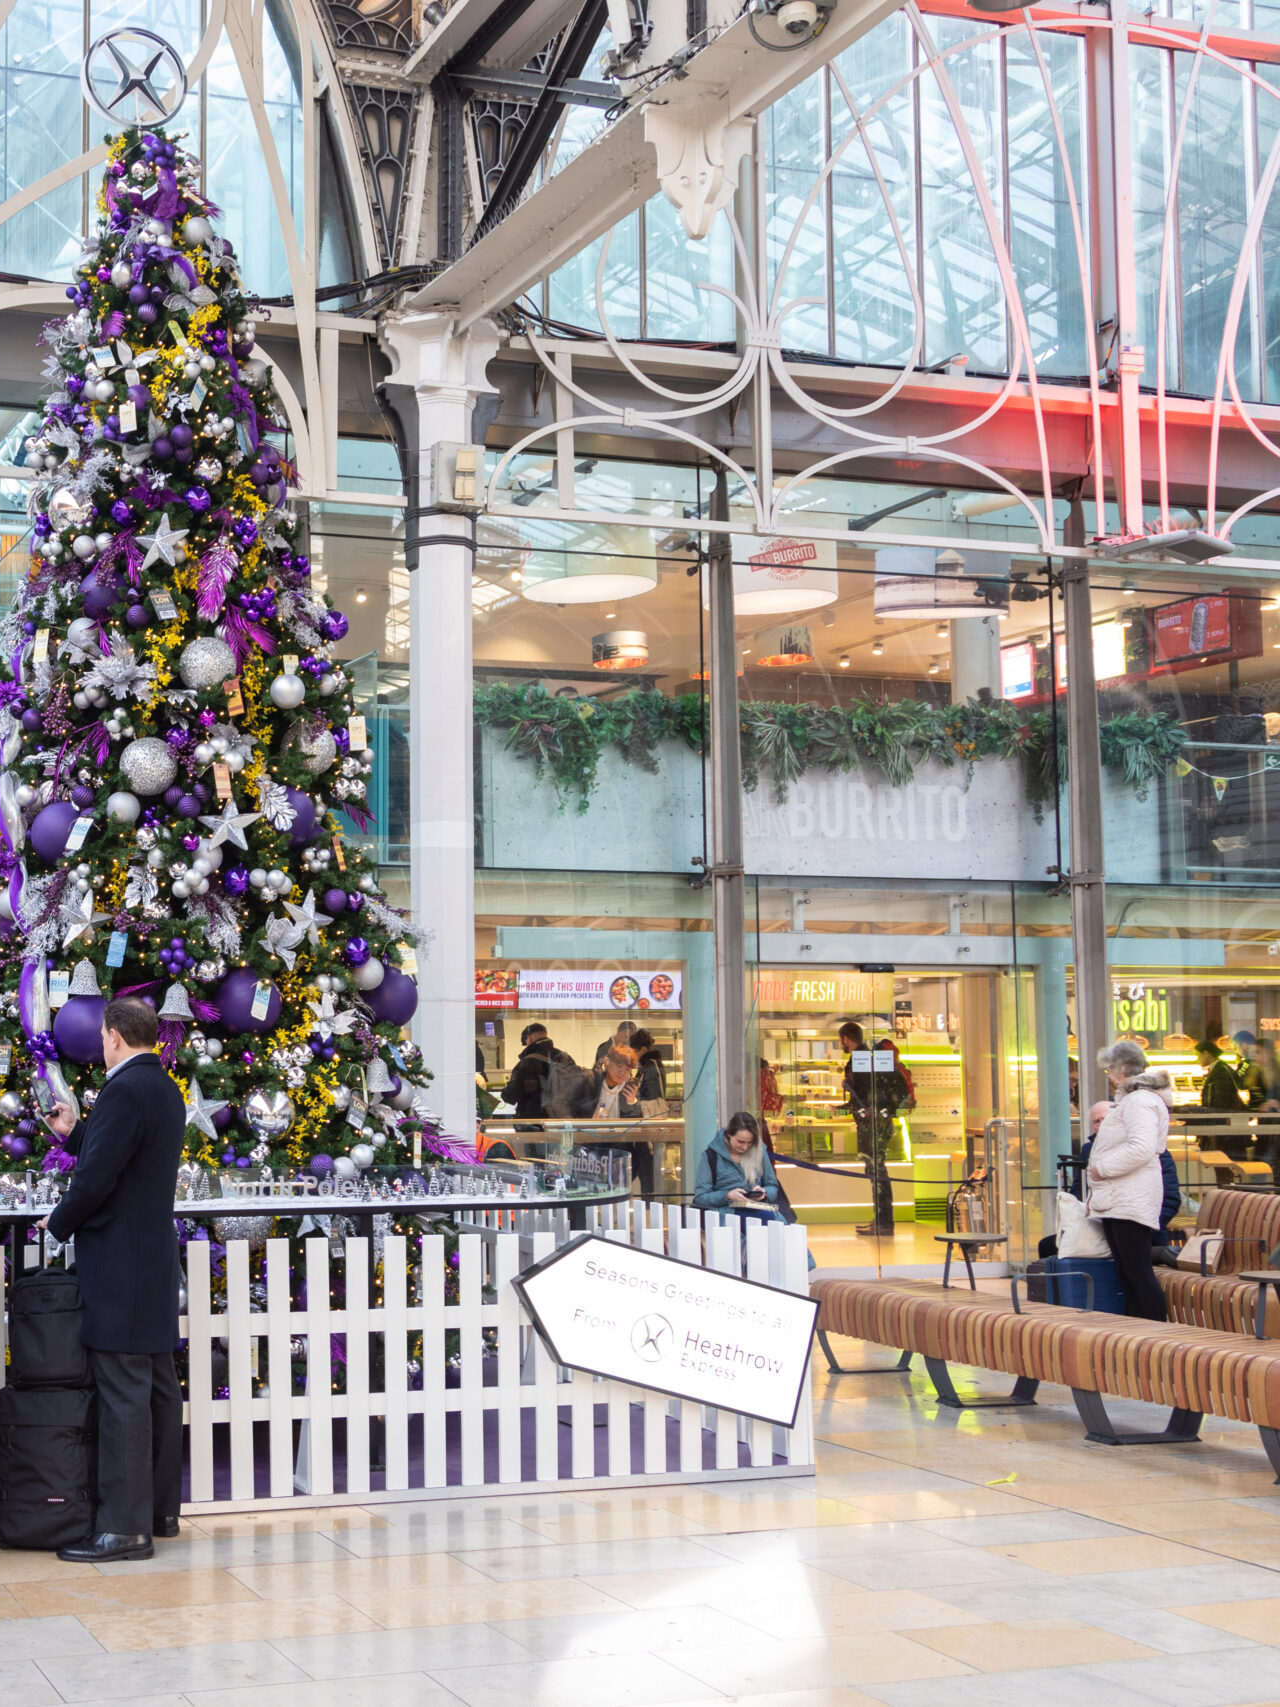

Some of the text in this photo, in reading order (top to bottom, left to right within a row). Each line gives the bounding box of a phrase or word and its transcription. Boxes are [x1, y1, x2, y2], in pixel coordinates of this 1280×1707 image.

[51, 979, 68, 988] RIO
[545, 982, 555, 992] UP
[557, 982, 574, 992] THIS
[576, 982, 604, 992] WINTER
[793, 981, 836, 1002] FRESH
[256, 990, 269, 1000] RIO
[896, 1013, 932, 1030] sushi
[352, 1100, 367, 1111] LON
[221, 1173, 355, 1198] North Pole
[584, 1260, 659, 1294] Seasons
[573, 1308, 617, 1331] From
[684, 1330, 784, 1375] Heathrow
[680, 1353, 737, 1383] Express
